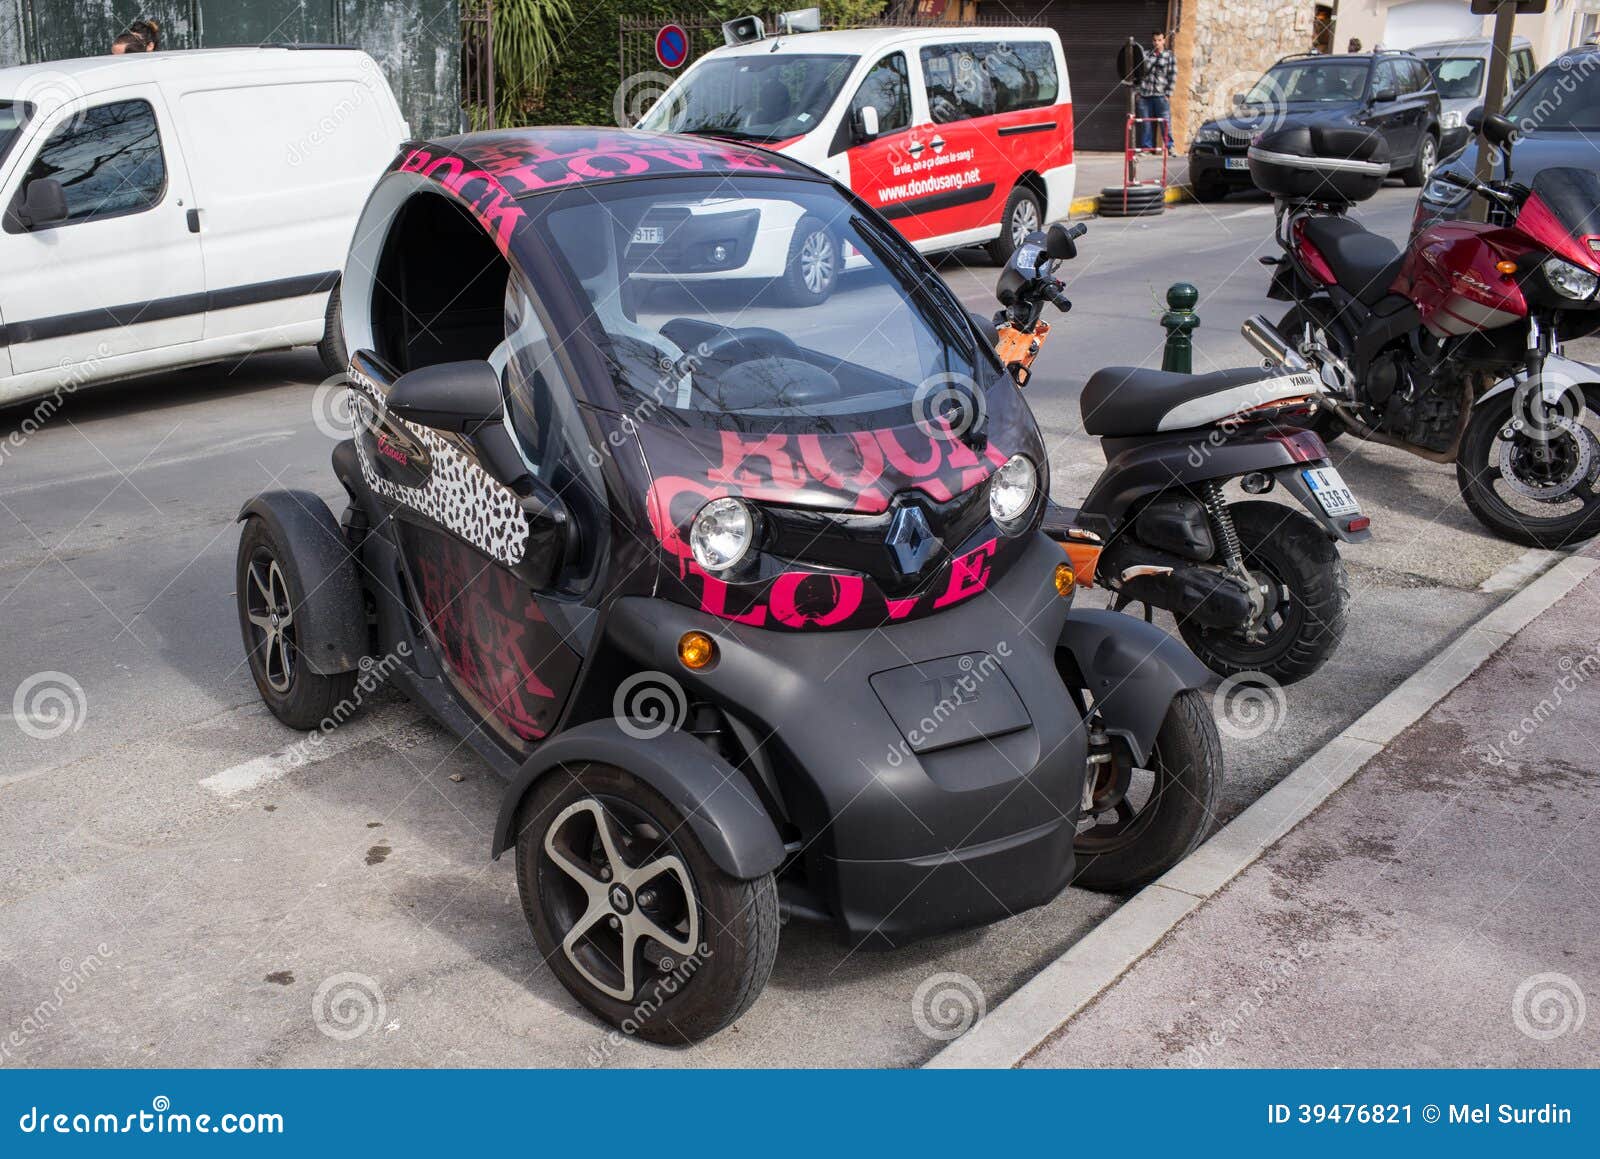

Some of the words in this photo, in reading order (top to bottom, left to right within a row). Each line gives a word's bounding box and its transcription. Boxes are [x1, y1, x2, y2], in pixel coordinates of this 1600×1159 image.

[518, 147, 786, 193] LOVE
[878, 168, 981, 202] www.dondusang.net
[401, 149, 527, 258] ROCK
[1319, 490, 1345, 508] 336
